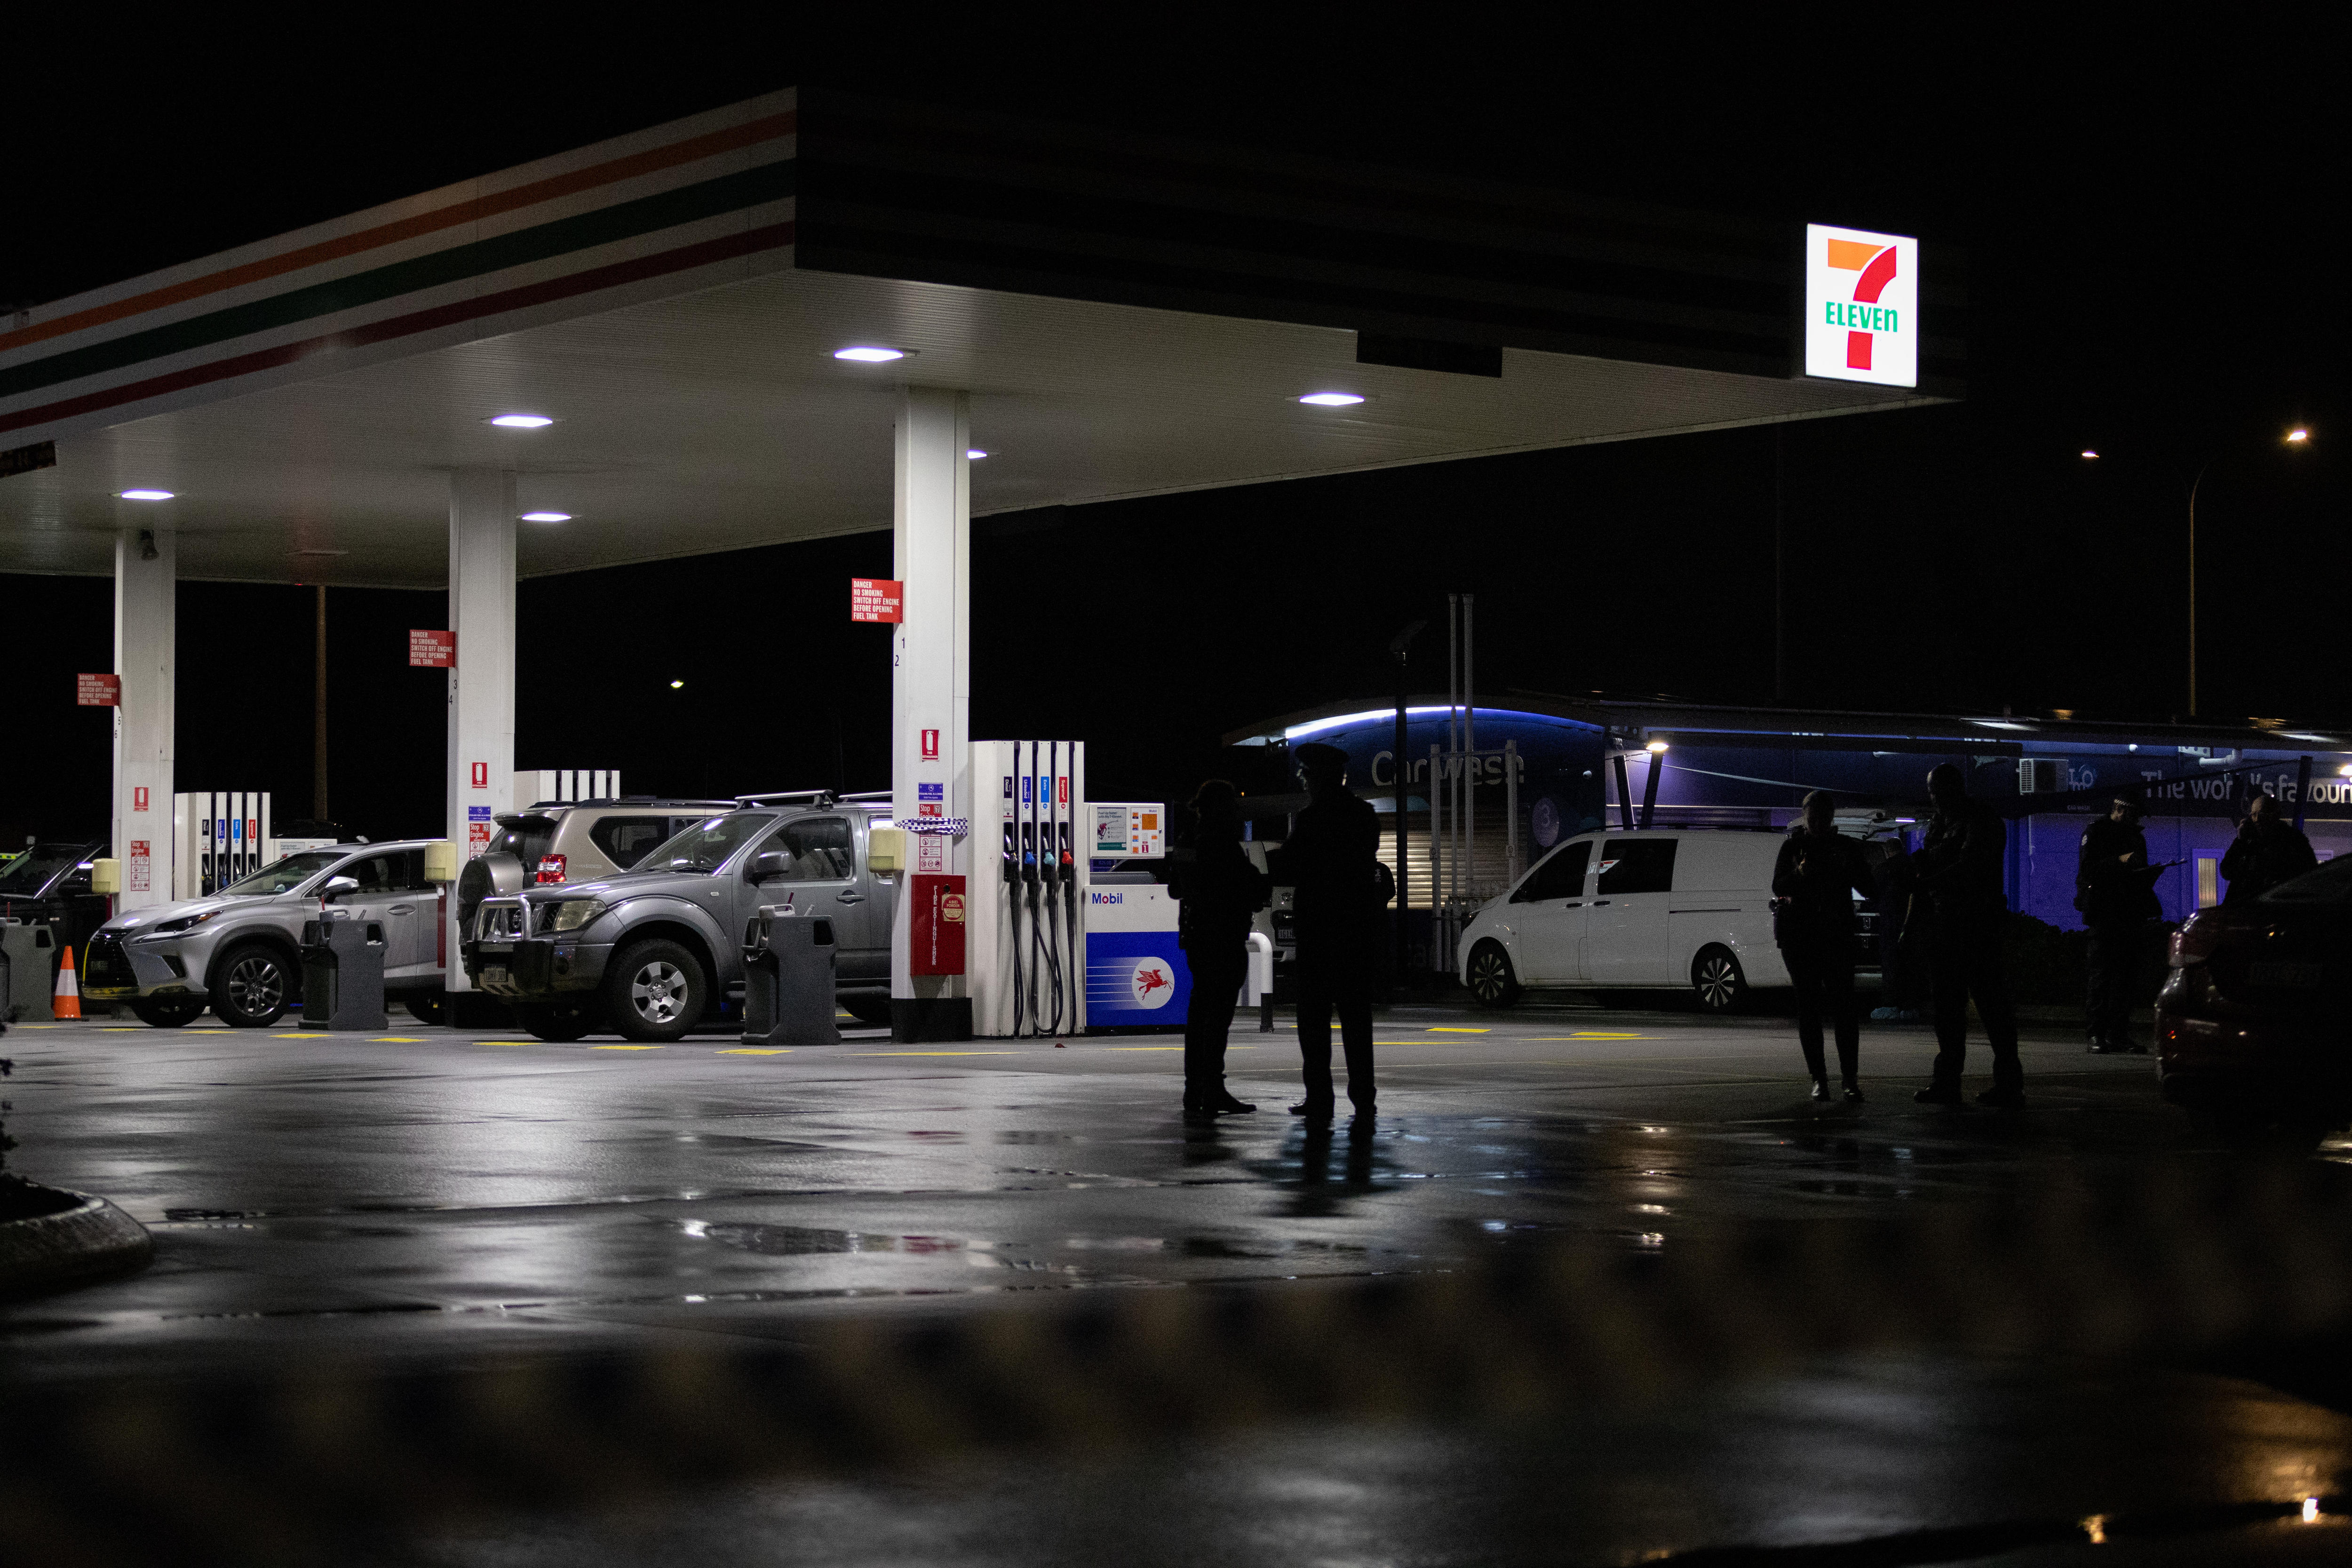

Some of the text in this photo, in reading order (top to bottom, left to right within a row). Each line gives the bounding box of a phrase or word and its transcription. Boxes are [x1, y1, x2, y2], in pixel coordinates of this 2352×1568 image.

[902, 637, 905, 649] 1
[894, 654, 899, 667] 2
[453, 679, 458, 690] 3
[449, 695, 453, 705] 4
[2141, 770, 2185, 799] The
[920, 804, 930, 813] Stop
[470, 831, 484, 839] Engine
[1092, 893, 1122, 904] Mobil
